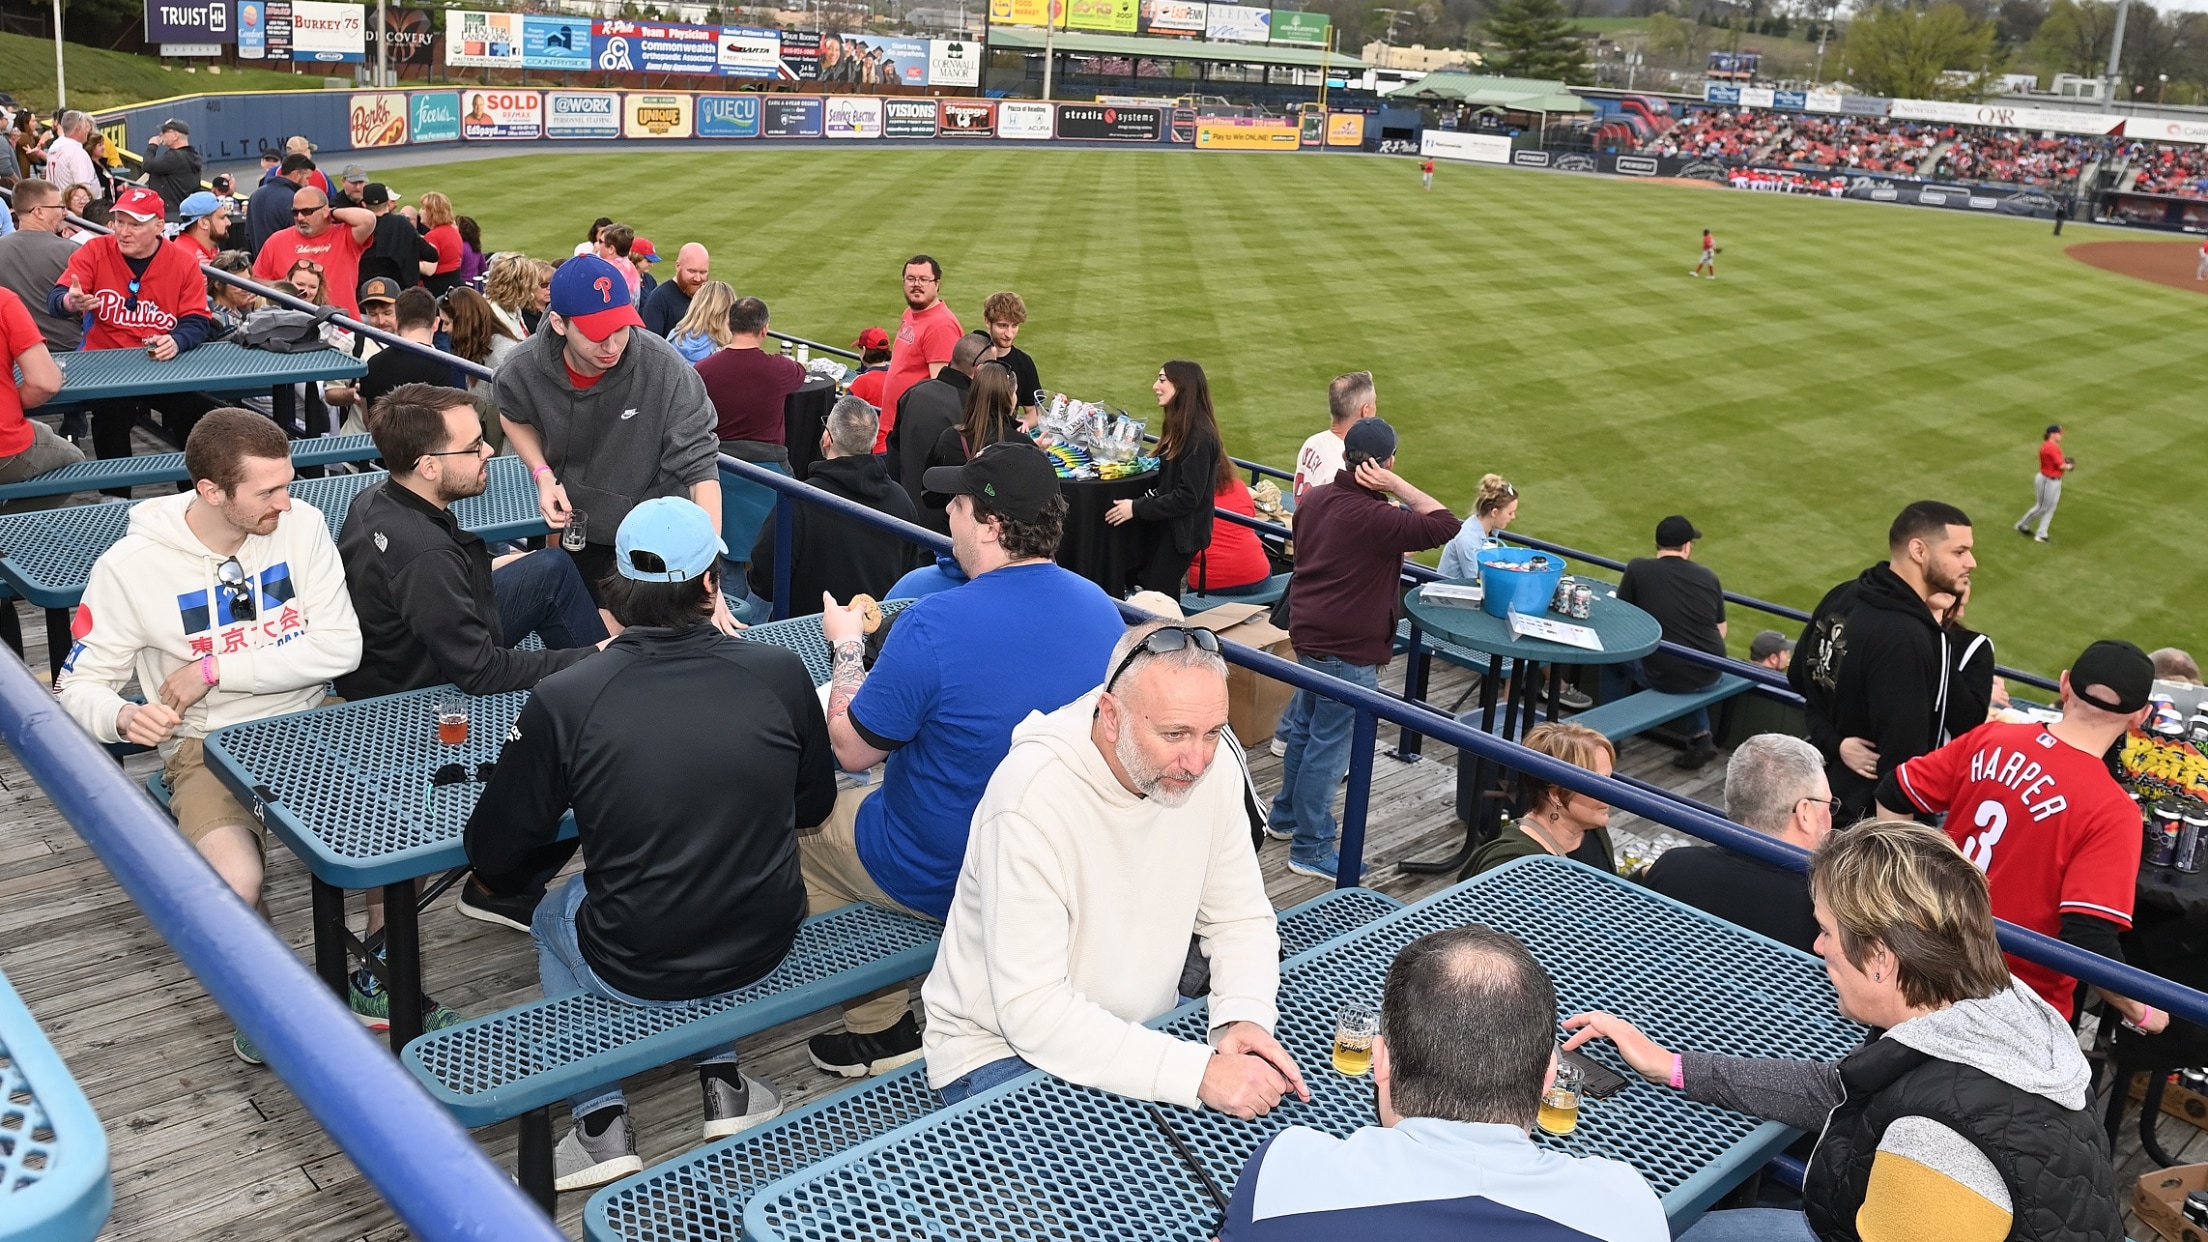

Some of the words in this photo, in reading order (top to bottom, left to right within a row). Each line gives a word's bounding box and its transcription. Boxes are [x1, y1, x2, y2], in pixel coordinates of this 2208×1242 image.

[160, 7, 207, 25] TRUIST
[294, 15, 341, 30] BURKEY
[345, 18, 359, 29] 75
[366, 31, 433, 45] DICOVERY
[641, 26, 665, 38] Team
[668, 28, 710, 41] Physician
[641, 40, 716, 53] Commonwealth
[682, 54, 716, 63] Associates
[933, 58, 976, 70] CORNWALL
[939, 67, 969, 77] MANOR
[487, 95, 538, 110] SOLD
[555, 97, 610, 113] @WORK
[714, 100, 755, 118] UECU
[502, 111, 531, 119] RE/MAX
[639, 109, 680, 124] UNIQUE
[853, 109, 877, 122] ELECTRIC
[887, 104, 936, 118] VISIONS
[945, 106, 988, 117] Storage
[1065, 110, 1103, 120] stratix
[1117, 113, 1154, 123] systems
[352, 95, 390, 143] Berks
[593, 276, 612, 304] P
[1970, 746, 2068, 823] HARPER
[1963, 799, 2008, 874] 3
